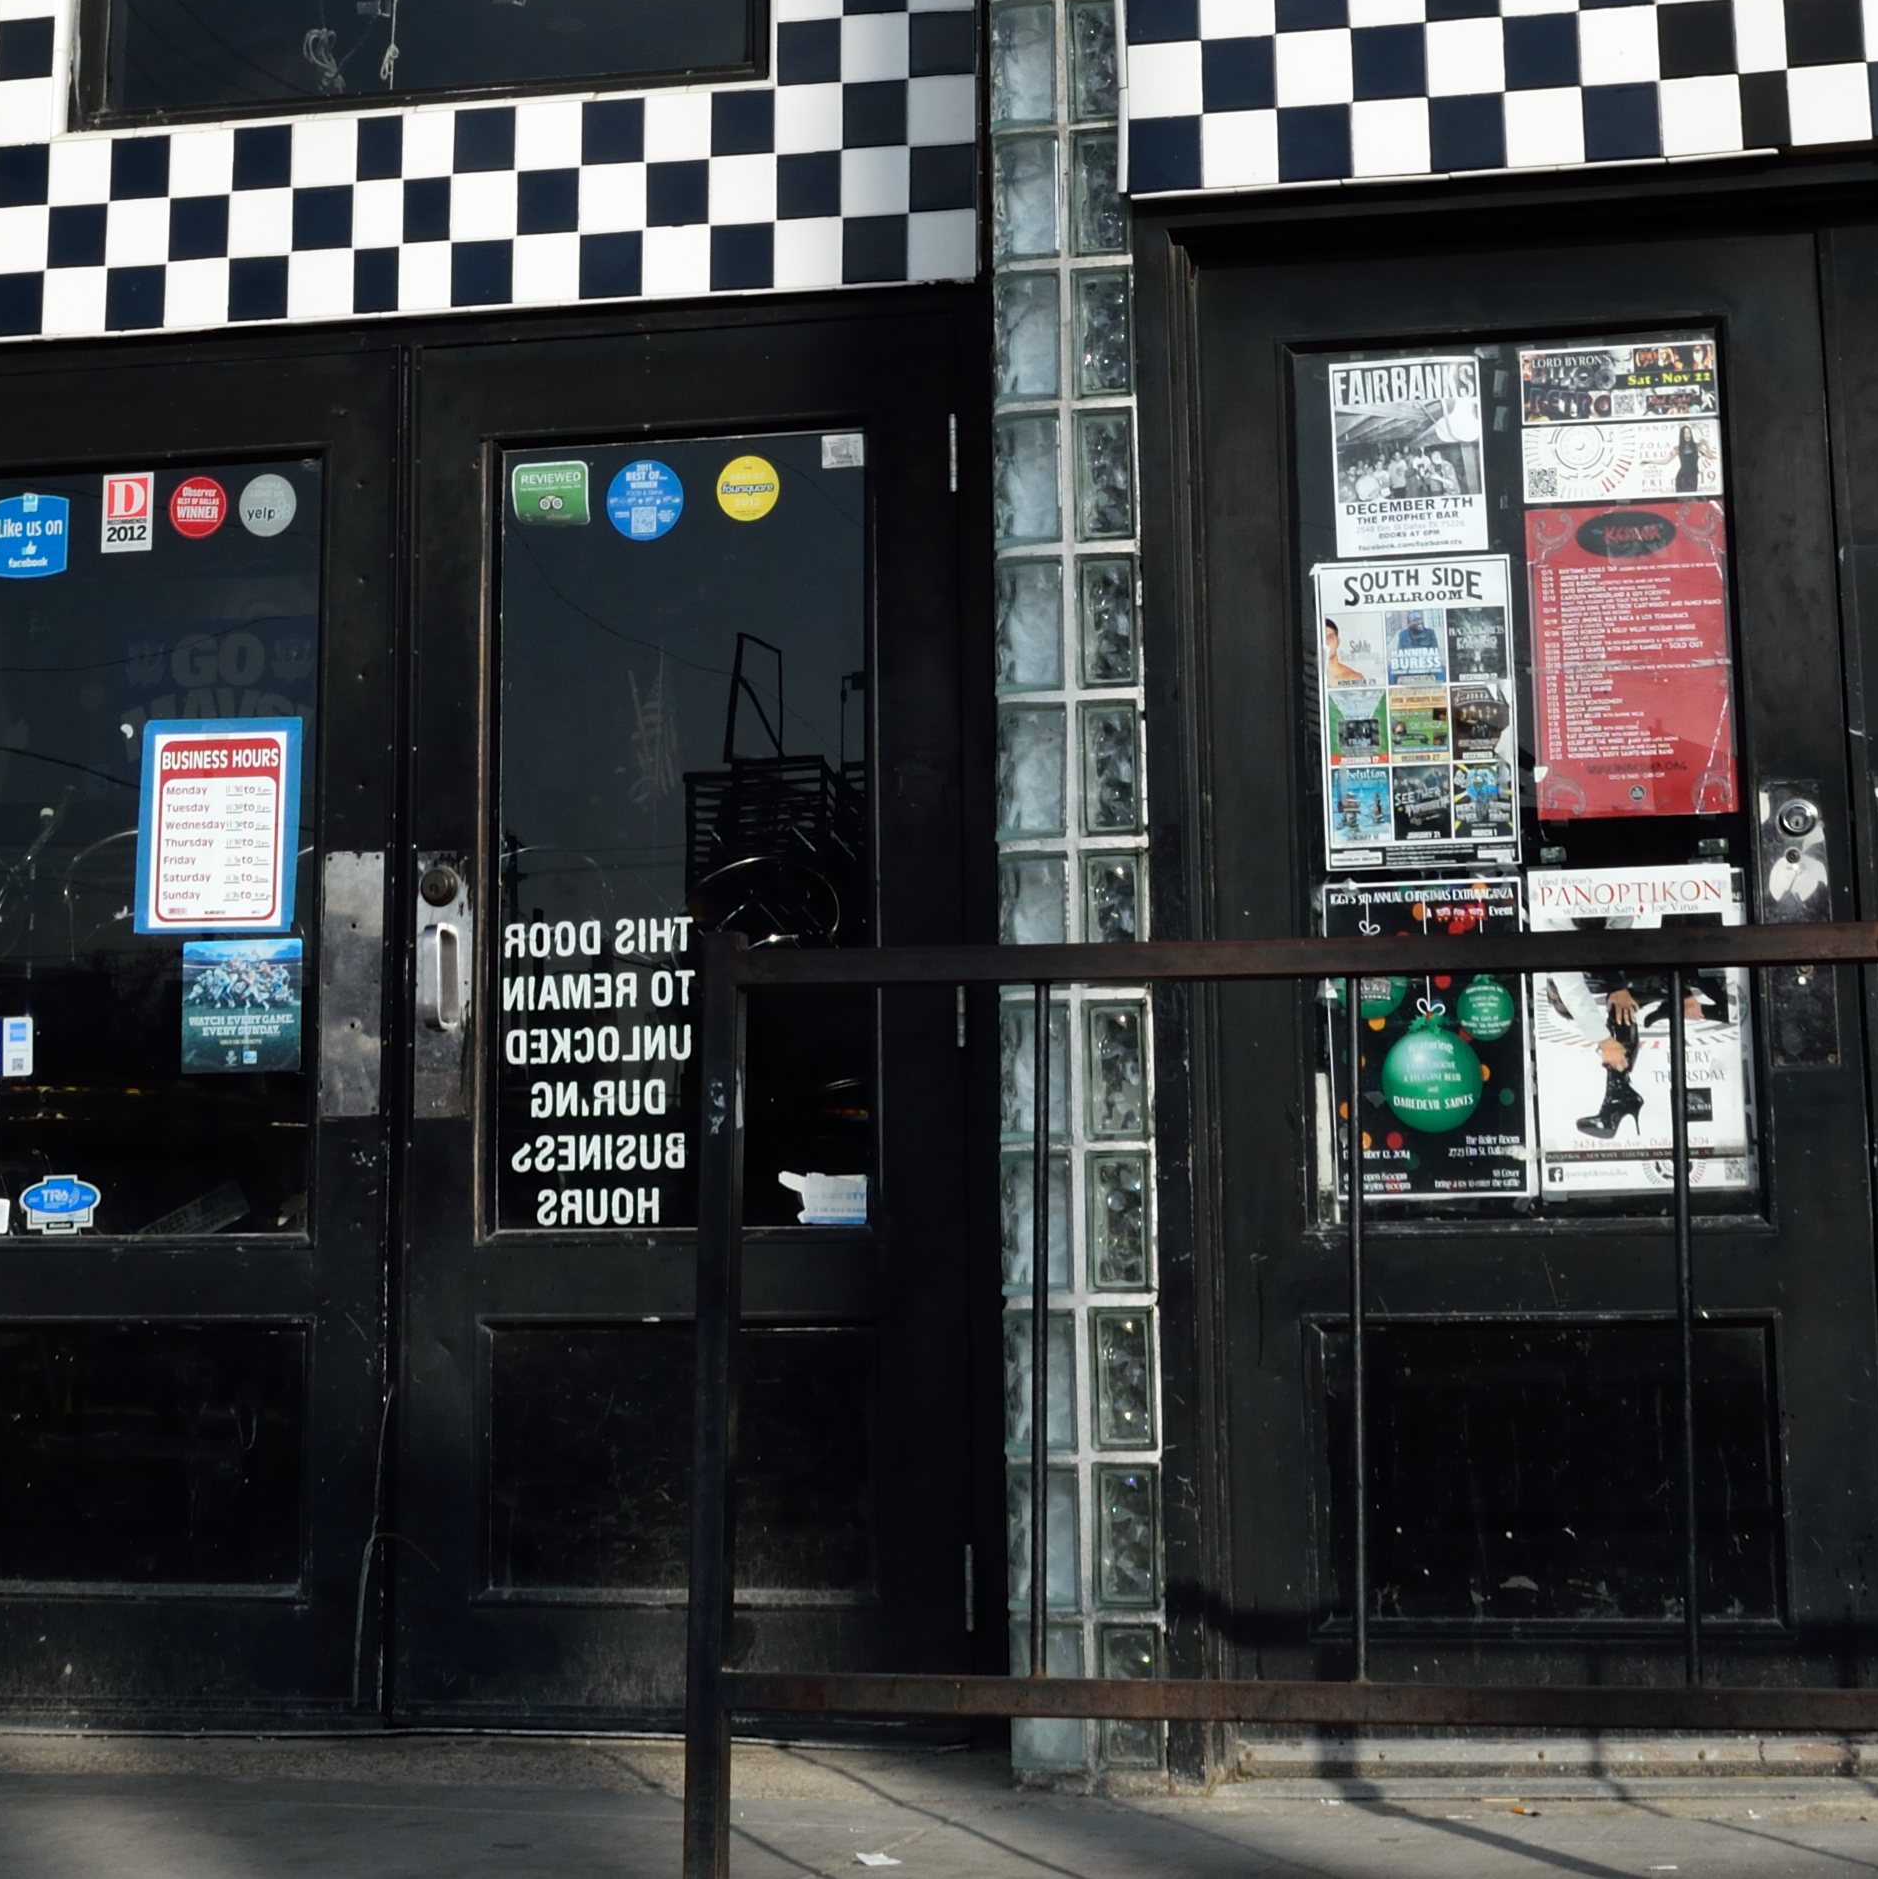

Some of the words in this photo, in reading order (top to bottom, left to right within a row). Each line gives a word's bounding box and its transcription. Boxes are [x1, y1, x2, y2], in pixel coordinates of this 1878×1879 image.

[1532, 357, 1562, 369] LORD
[1565, 354, 1612, 367] BYRON'S
[1628, 374, 1651, 385] Sat
[1662, 373, 1690, 383] Nov
[1695, 373, 1711, 381] 22
[521, 472, 581, 485] REVIEWED
[626, 471, 645, 481] BEST
[182, 487, 217, 497] Observer
[250, 489, 270, 497] LOVE
[273, 489, 285, 497] US
[722, 482, 774, 496] foursquare
[110, 481, 145, 516] D
[200, 497, 219, 505] DALLAS
[734, 497, 760, 506] 2012
[1346, 498, 1435, 515] DECEMBER
[1441, 497, 1473, 508] 7TH
[177, 506, 218, 519] WINNER
[247, 507, 276, 521] yelp
[1357, 517, 1377, 525] THE
[1382, 512, 1432, 523] PROPHET
[1437, 511, 1459, 519] BAR
[26, 521, 42, 536] us
[45, 519, 62, 536] on
[106, 525, 147, 542] 2012
[8, 557, 48, 568] facebook
[1344, 569, 1419, 606] SOUTH
[1432, 567, 1482, 600] SIDE
[1363, 590, 1463, 604] BALLROOM
[171, 633, 266, 687] GO
[1391, 657, 1441, 669] BURESS
[162, 750, 228, 770] BUSINESS
[232, 748, 279, 768] HOURS
[166, 786, 207, 796] Monday
[244, 786, 255, 794] to
[166, 804, 210, 813] Tuesday
[244, 803, 255, 812] to
[166, 821, 226, 830] Wednesday
[243, 821, 254, 829] to
[165, 838, 214, 847] Thursday
[242, 838, 253, 846] to
[164, 856, 196, 866] Friday
[242, 856, 253, 864] to
[163, 873, 211, 883] Saturday
[241, 873, 252, 881] to
[163, 891, 200, 900] Sunday
[241, 891, 251, 899] to
[1540, 880, 1722, 906] PANOPTIKON
[1614, 905, 1635, 913] Sam
[189, 1016, 225, 1026] WATCH
[227, 1015, 262, 1025] EVERY
[262, 1014, 295, 1024] GAME.
[202, 1027, 236, 1037] EVERY
[238, 1025, 280, 1035] SUNDAY.
